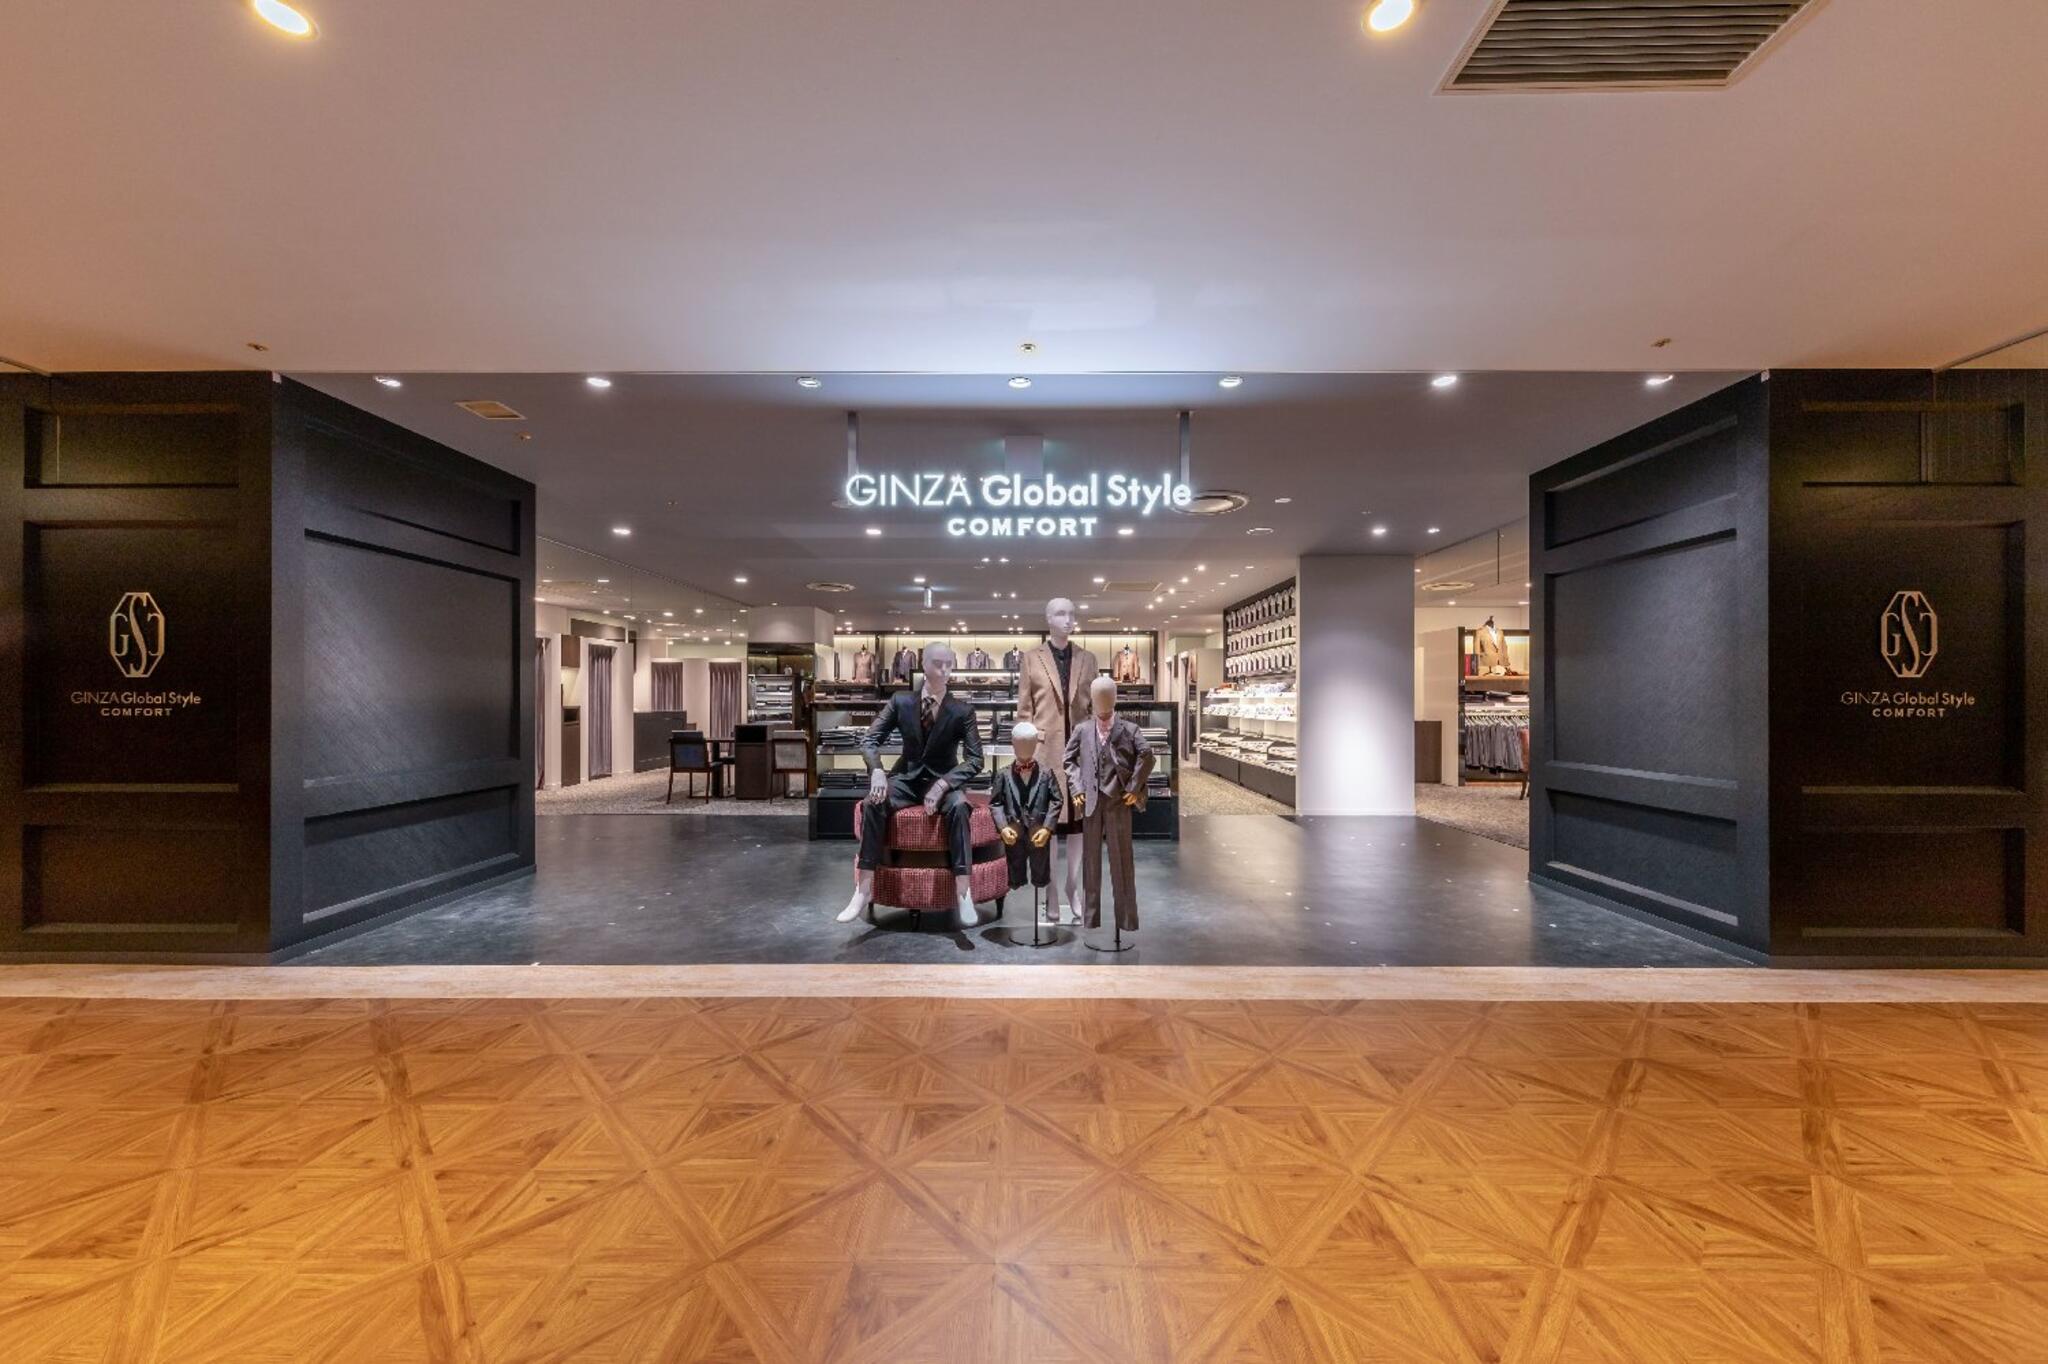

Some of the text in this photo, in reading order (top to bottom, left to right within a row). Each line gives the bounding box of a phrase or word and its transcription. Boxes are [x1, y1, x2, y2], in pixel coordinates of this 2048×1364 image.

[846, 473, 1192, 514] GINZA Global Style
[948, 517, 1098, 536] COMFORT
[70, 691, 202, 708] GINZA Global Style
[1841, 691, 1976, 708] GINZA Global Style
[101, 708, 172, 716] COMFORT
[1872, 708, 1946, 717] COMFORT
